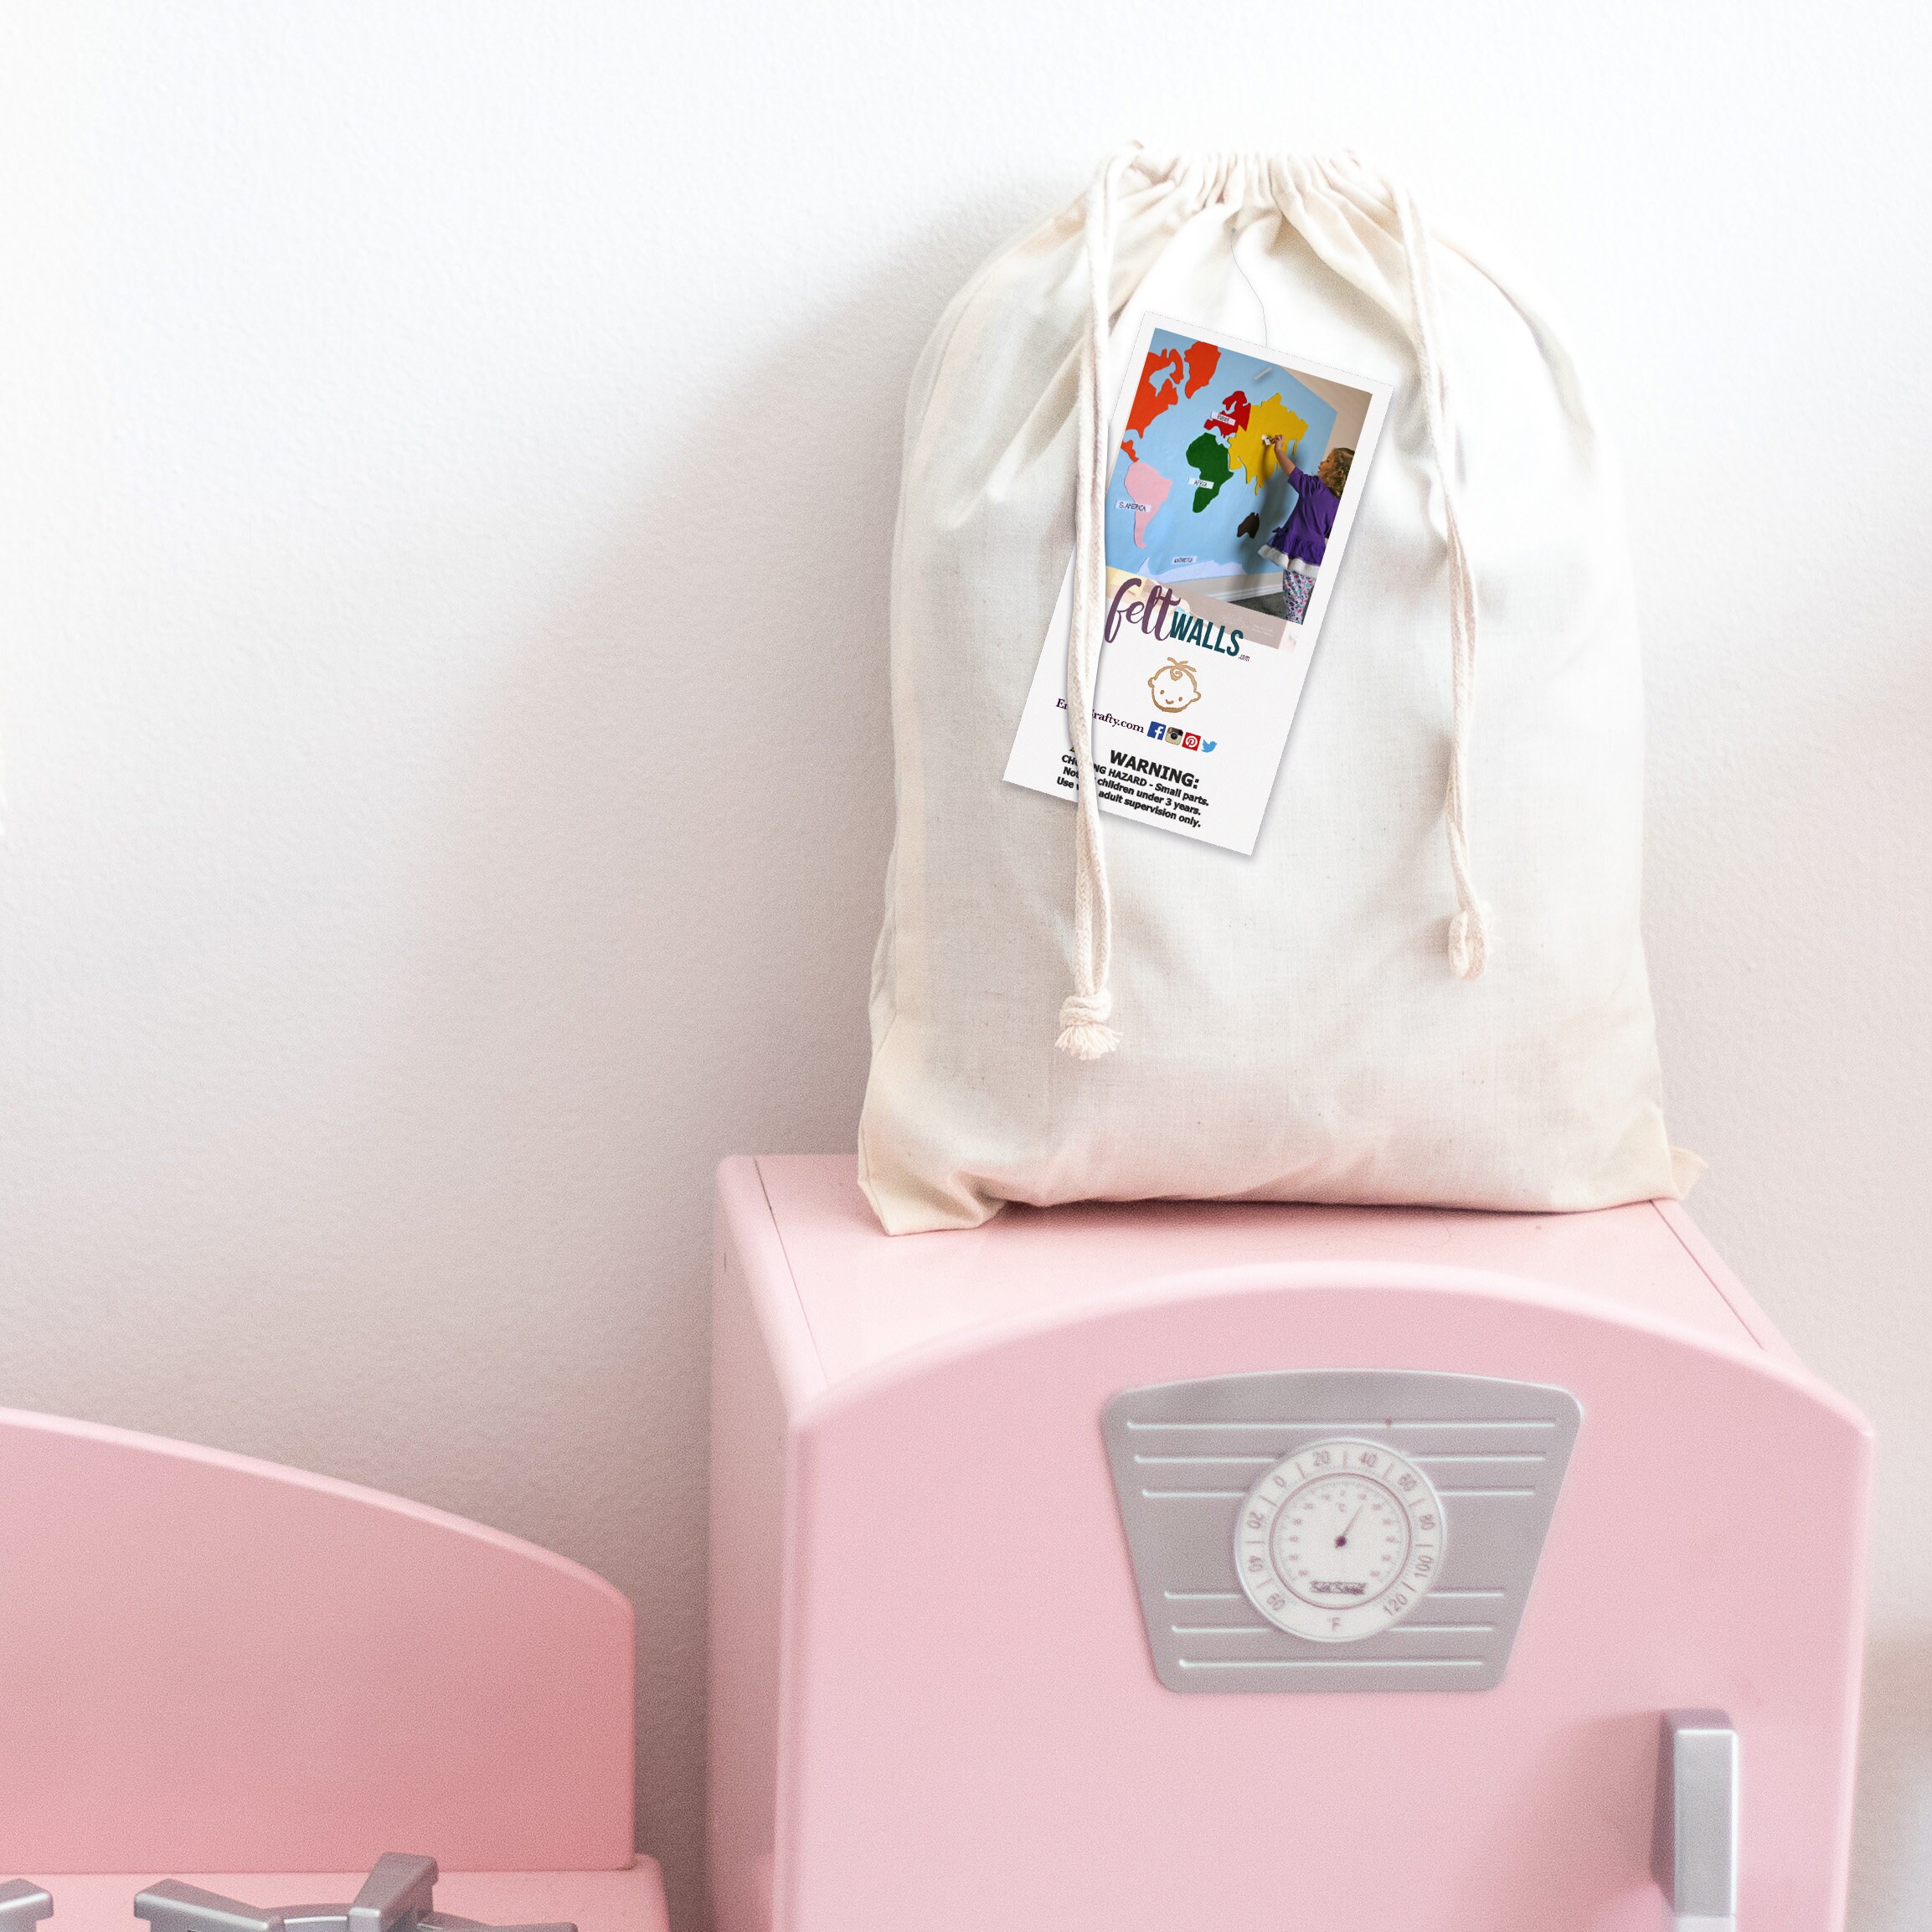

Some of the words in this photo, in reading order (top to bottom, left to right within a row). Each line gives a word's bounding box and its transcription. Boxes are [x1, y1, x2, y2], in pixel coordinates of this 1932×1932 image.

[1061, 755, 1107, 775] CHNG
[1108, 768, 1147, 787] HAZARD
[1155, 782, 1182, 798] Small
[1182, 791, 1209, 806] parts.
[1110, 750, 1199, 789] WARNING:
[1057, 776, 1074, 789] Use
[1098, 791, 1124, 804] adult
[1124, 798, 1177, 820] supervision
[1178, 817, 1201, 828] only.
[1097, 778, 1135, 796] children
[1136, 790, 1165, 804] under
[1165, 797, 1172, 806] 3
[1173, 801, 1201, 816] years.
[1313, 1450, 1331, 1466] 20
[1360, 1451, 1378, 1467] 40
[1246, 1511, 1265, 1530] 20
[1414, 1554, 1434, 1579] 100
[1383, 1593, 1408, 1616] 120
